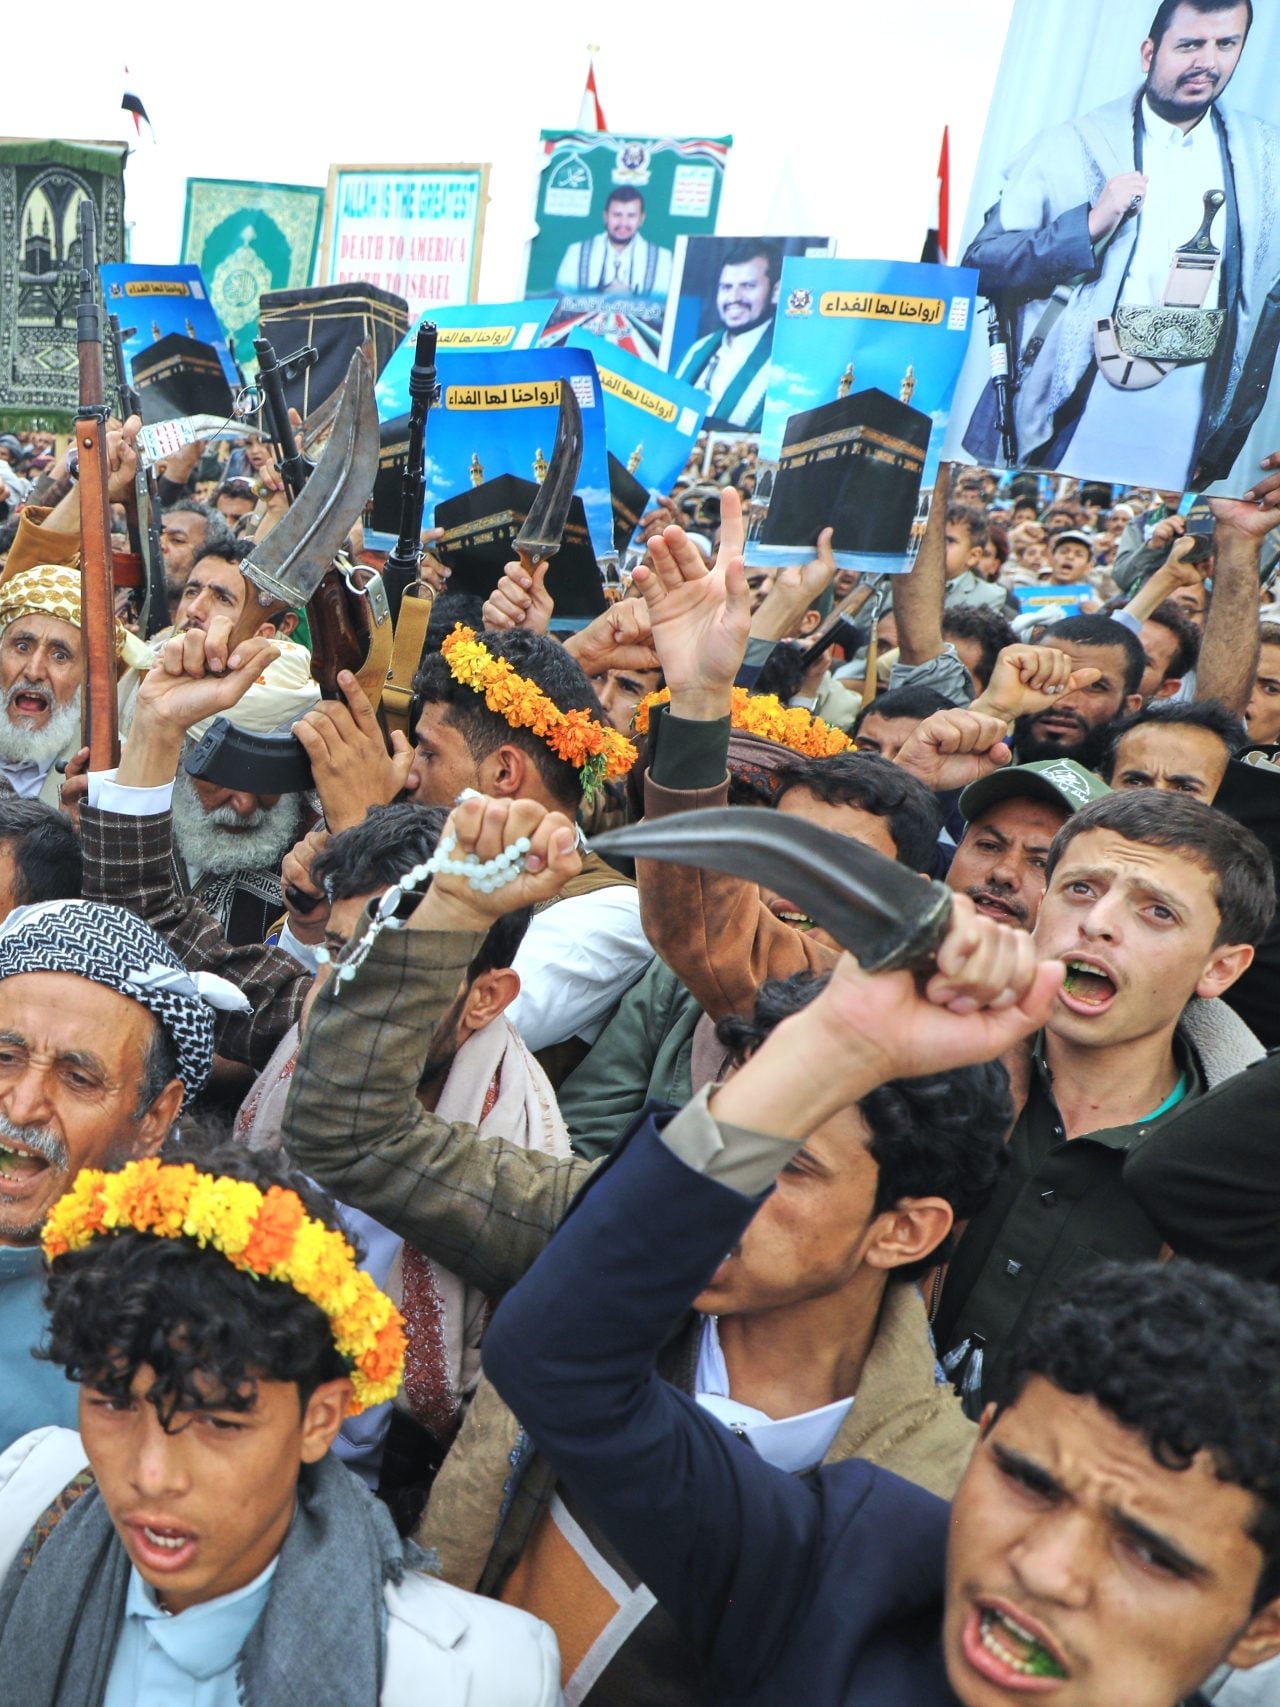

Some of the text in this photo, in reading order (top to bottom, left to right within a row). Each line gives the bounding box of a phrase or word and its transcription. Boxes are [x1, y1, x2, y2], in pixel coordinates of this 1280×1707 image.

[340, 235, 465, 262] DEATH TO AMERICA
[405, 274, 450, 300] ISRAEL
[825, 296, 872, 313] الفداء
[875, 298, 896, 316] لها
[899, 300, 941, 323] أرواحنا
[448, 390, 481, 405] الفداء
[484, 388, 507, 405] لها
[512, 381, 559, 405] أرواحنا
[621, 383, 640, 401] لها
